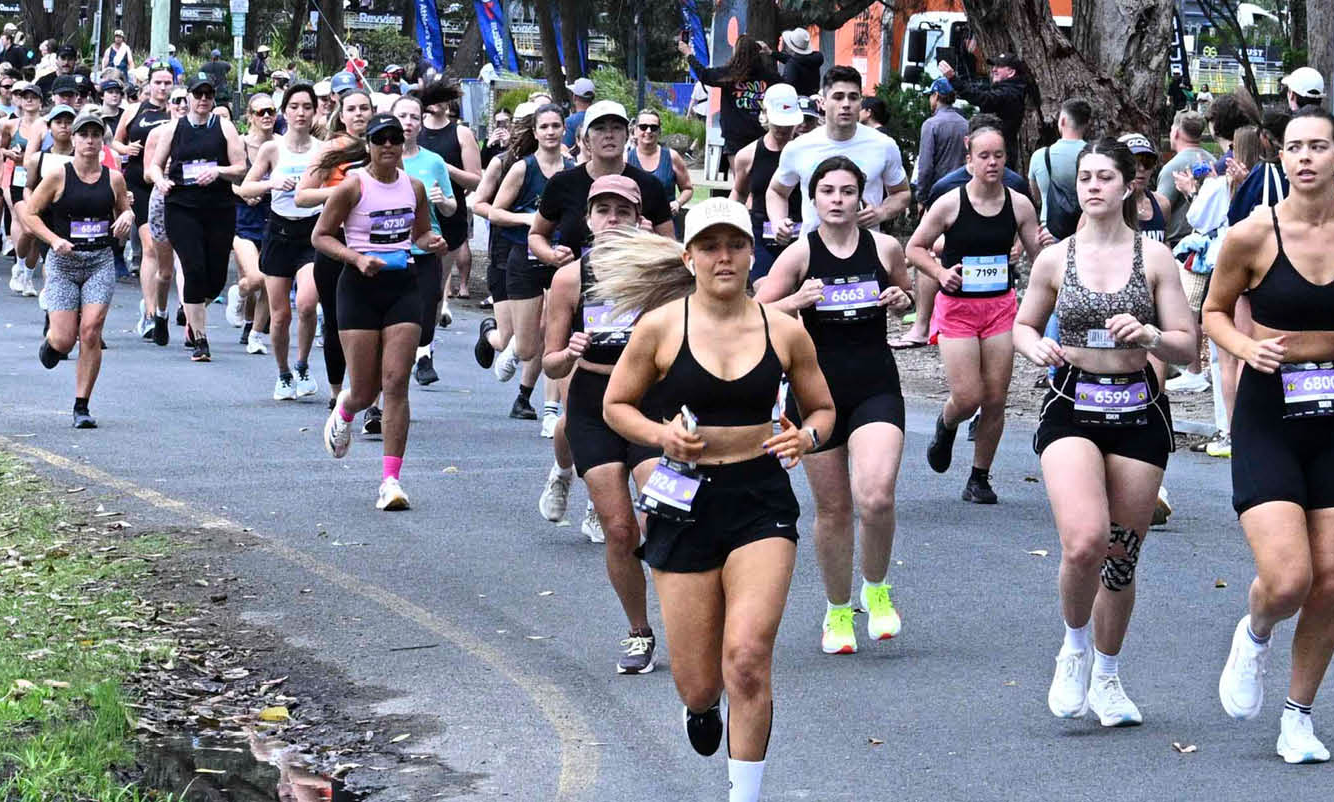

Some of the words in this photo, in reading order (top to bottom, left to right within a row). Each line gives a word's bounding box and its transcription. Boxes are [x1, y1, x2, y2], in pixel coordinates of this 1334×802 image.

[975, 268, 998, 278] 7199
[831, 287, 865, 302] 6663
[1094, 390, 1131, 404] 6599
